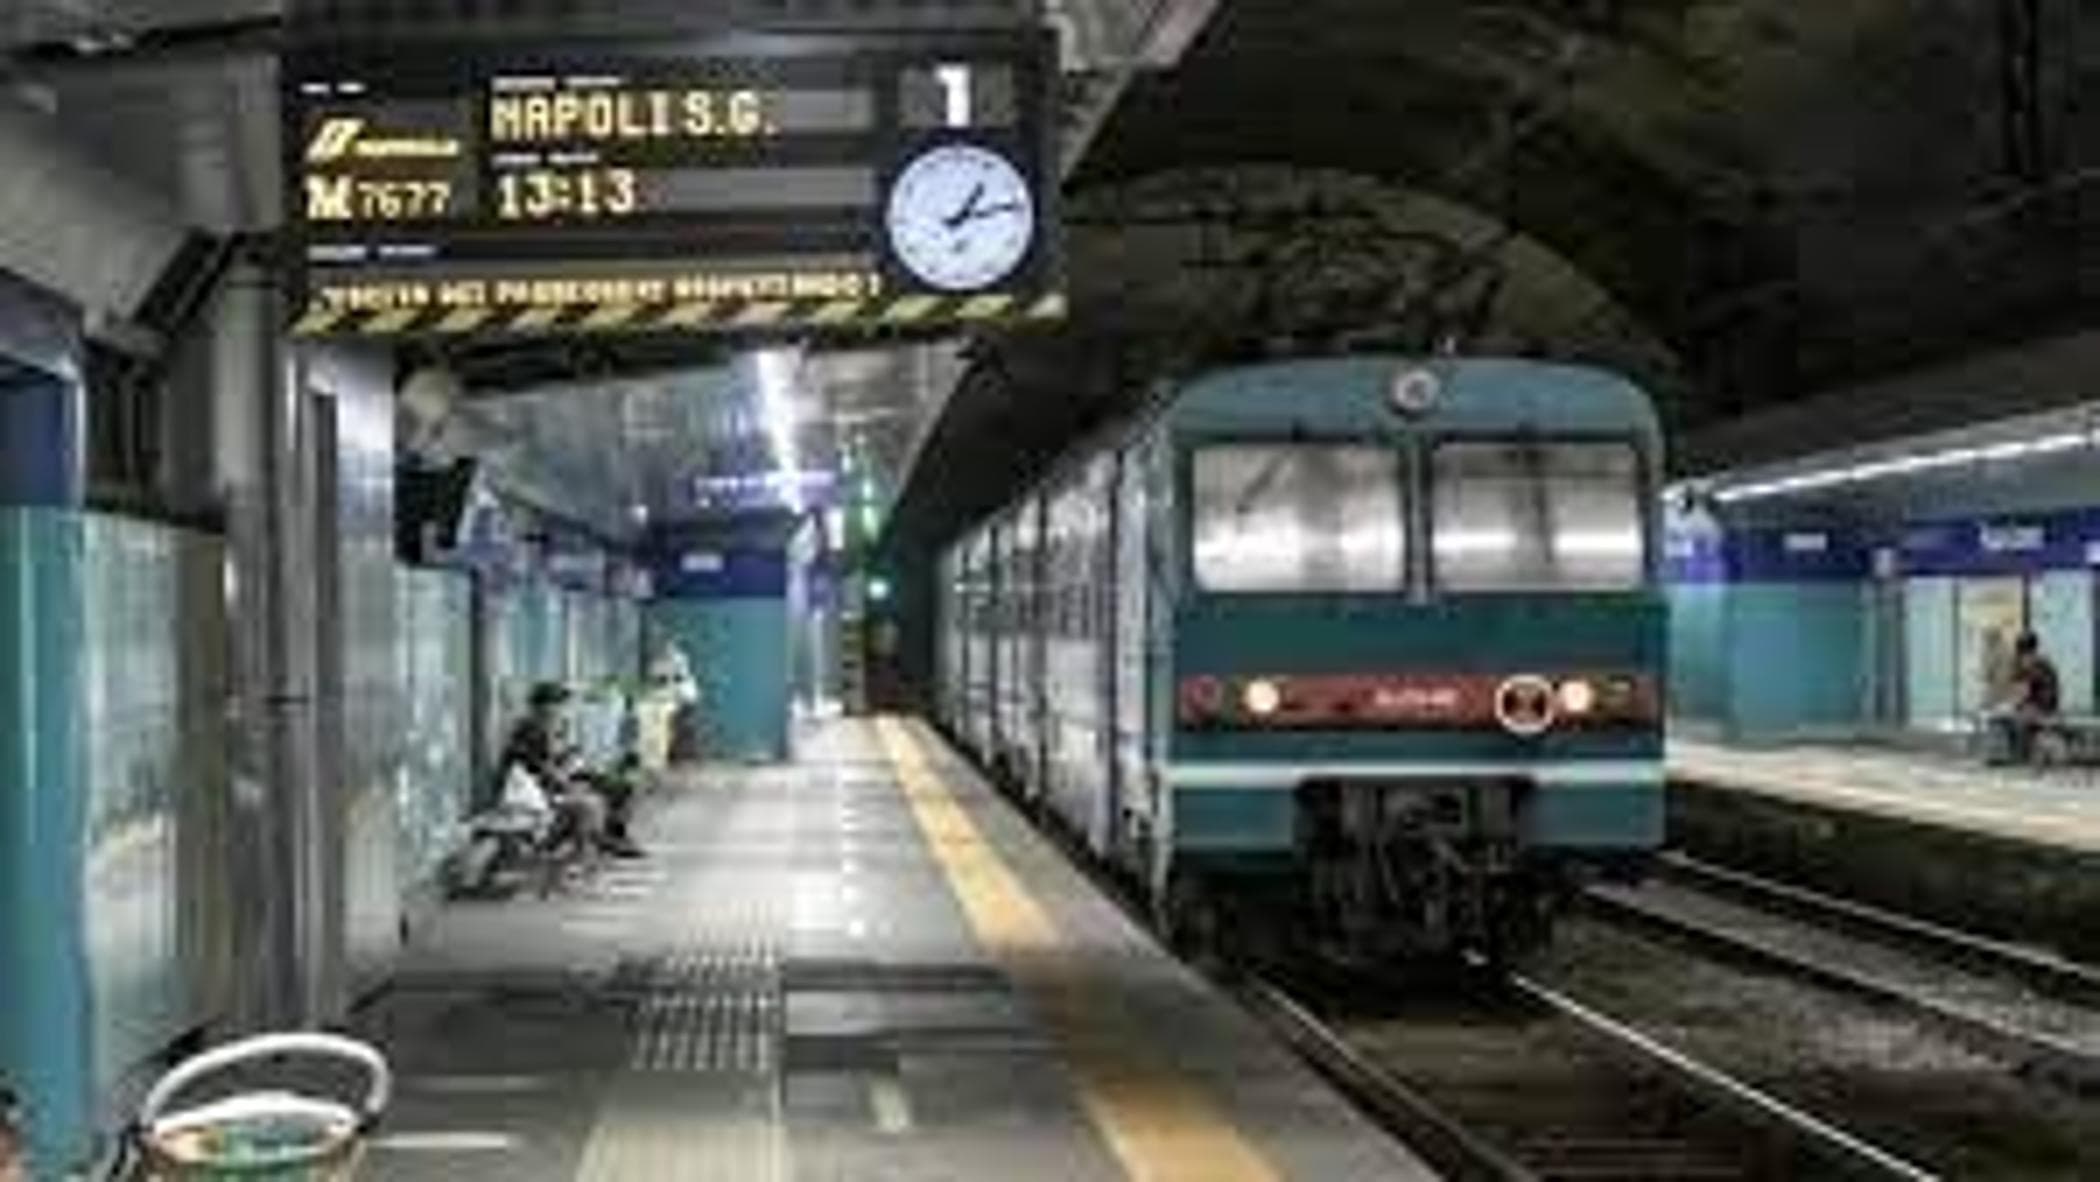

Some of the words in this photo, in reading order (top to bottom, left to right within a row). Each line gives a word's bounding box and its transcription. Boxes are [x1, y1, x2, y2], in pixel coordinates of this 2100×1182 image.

[490, 91, 671, 140] NAPOLI
[933, 64, 971, 128] 1
[306, 175, 353, 220] M
[499, 168, 635, 219] 13:13
